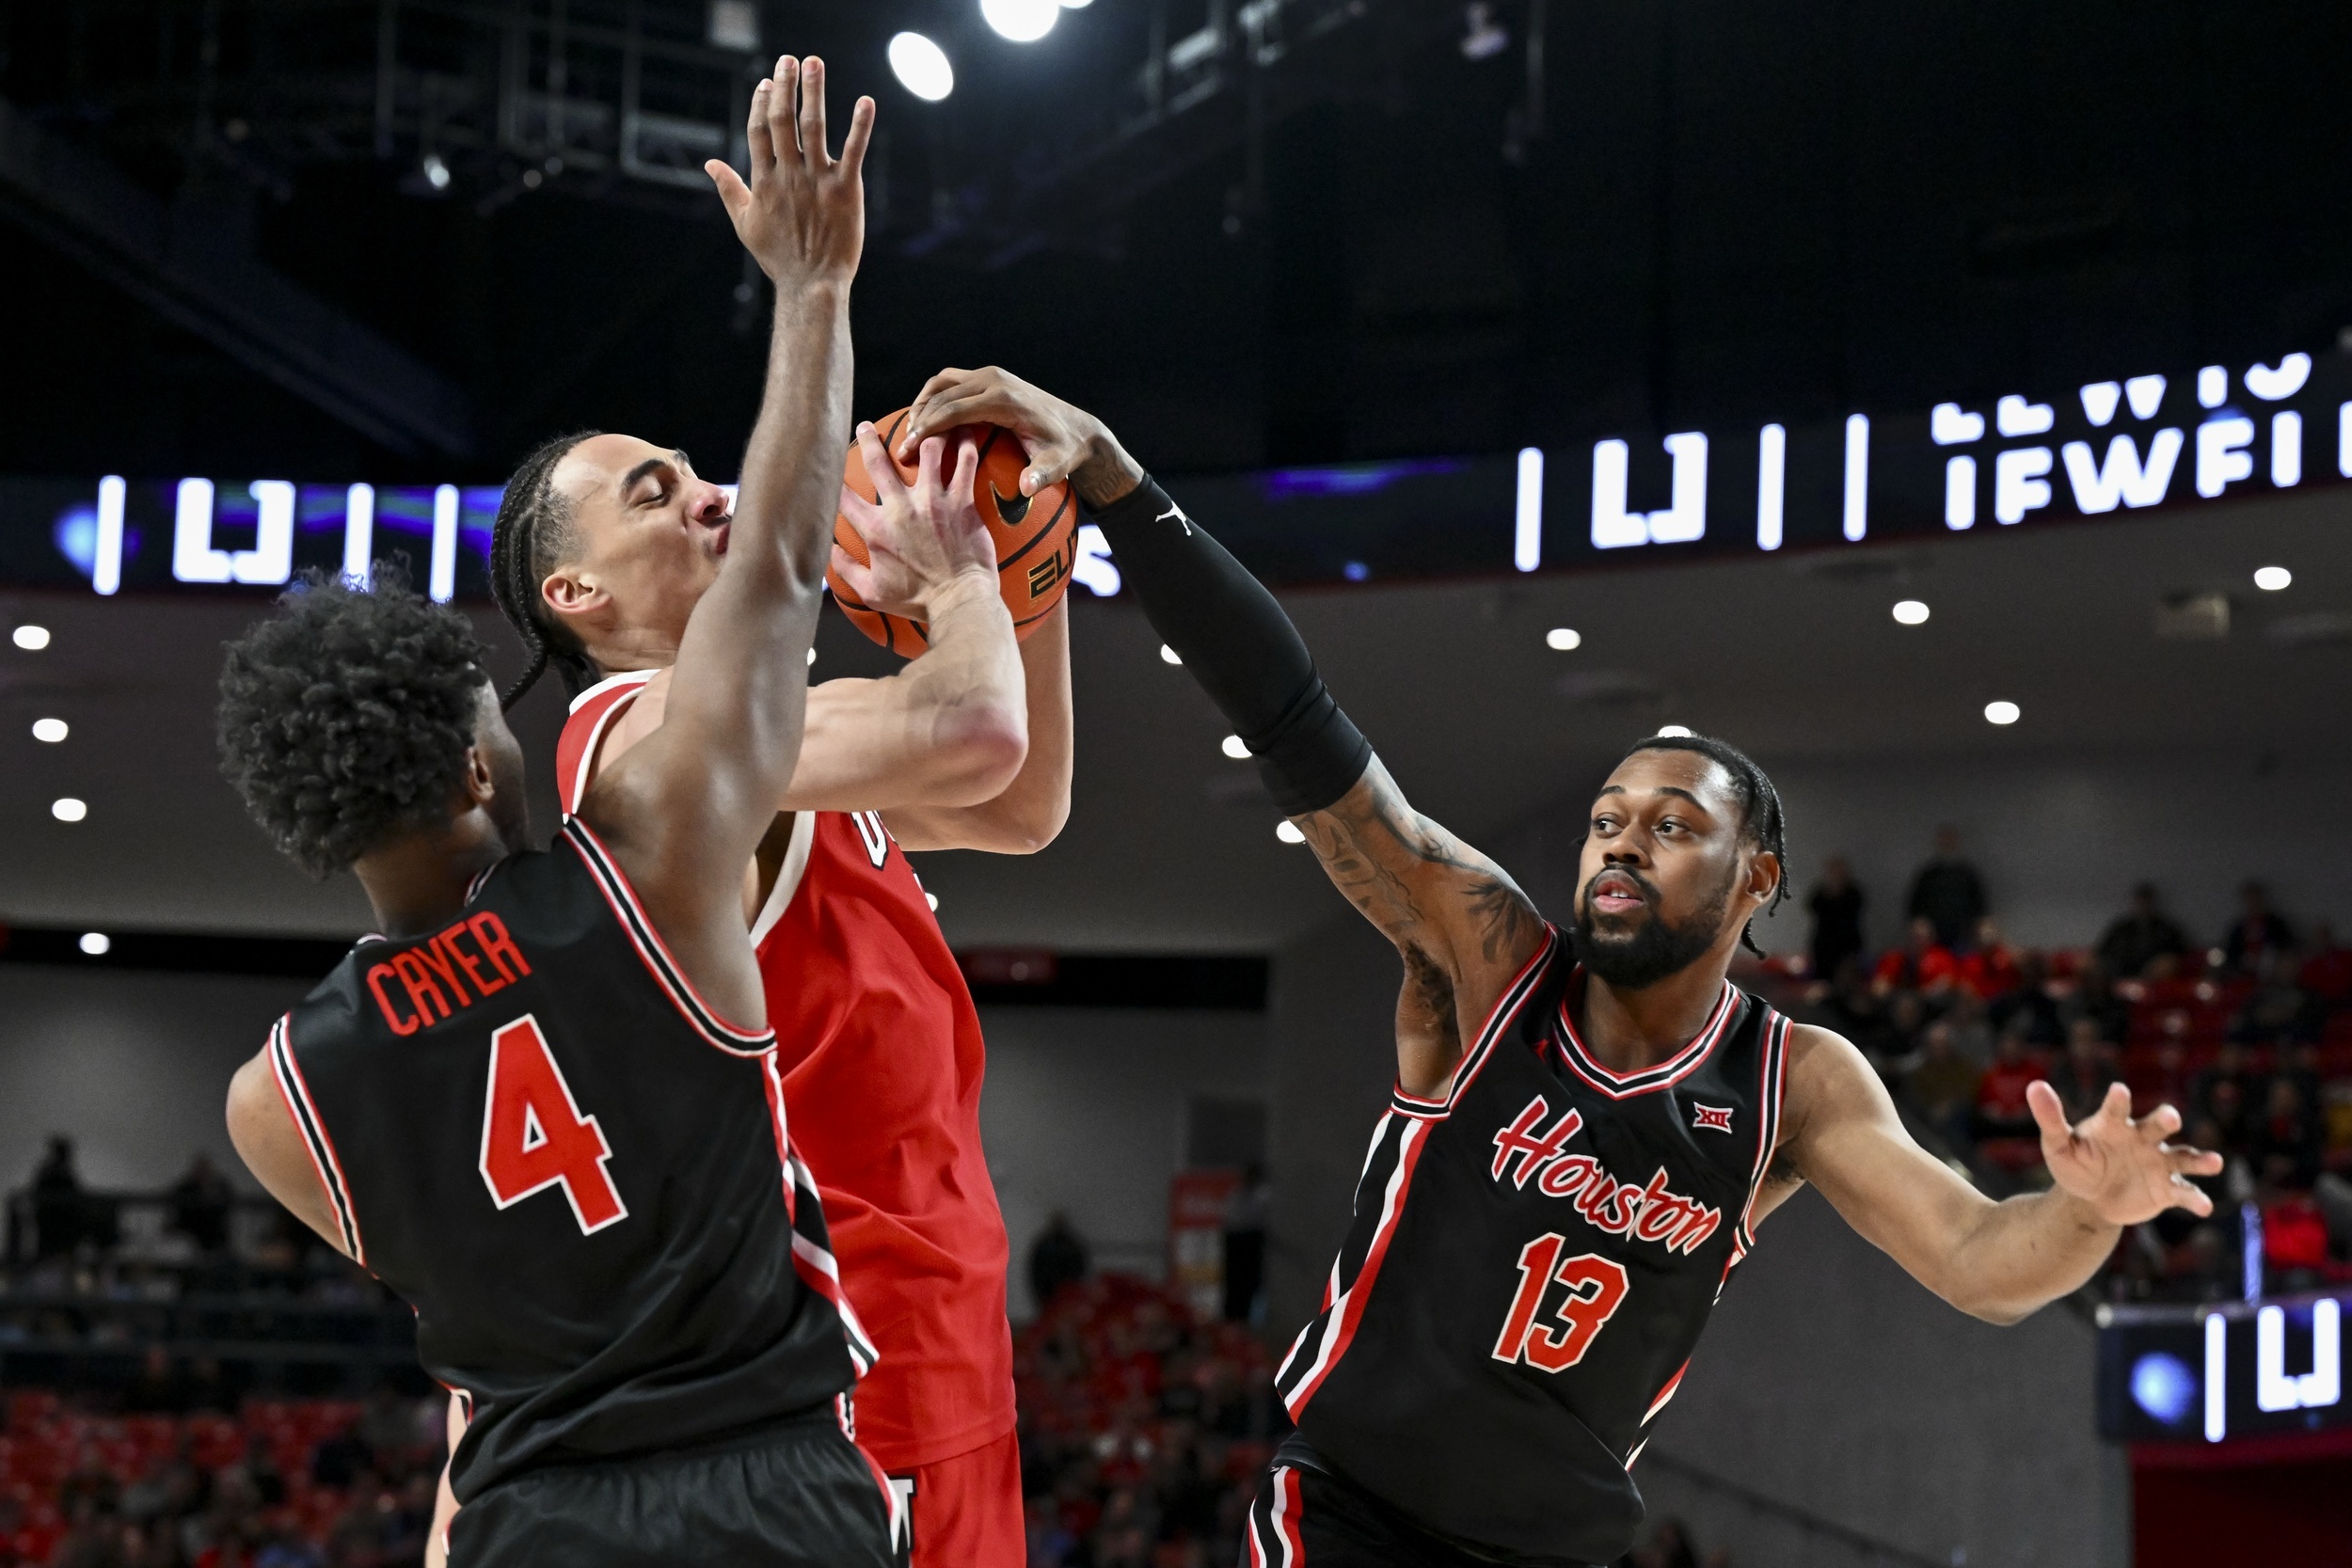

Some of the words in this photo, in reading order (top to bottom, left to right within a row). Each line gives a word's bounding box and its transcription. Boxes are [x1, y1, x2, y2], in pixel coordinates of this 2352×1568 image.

[1027, 526, 1077, 599] ELI
[366, 910, 532, 1037] CRYER
[479, 1012, 629, 1236] 4
[1491, 1093, 1722, 1256] Houston
[1491, 1231, 1630, 1374] 13
